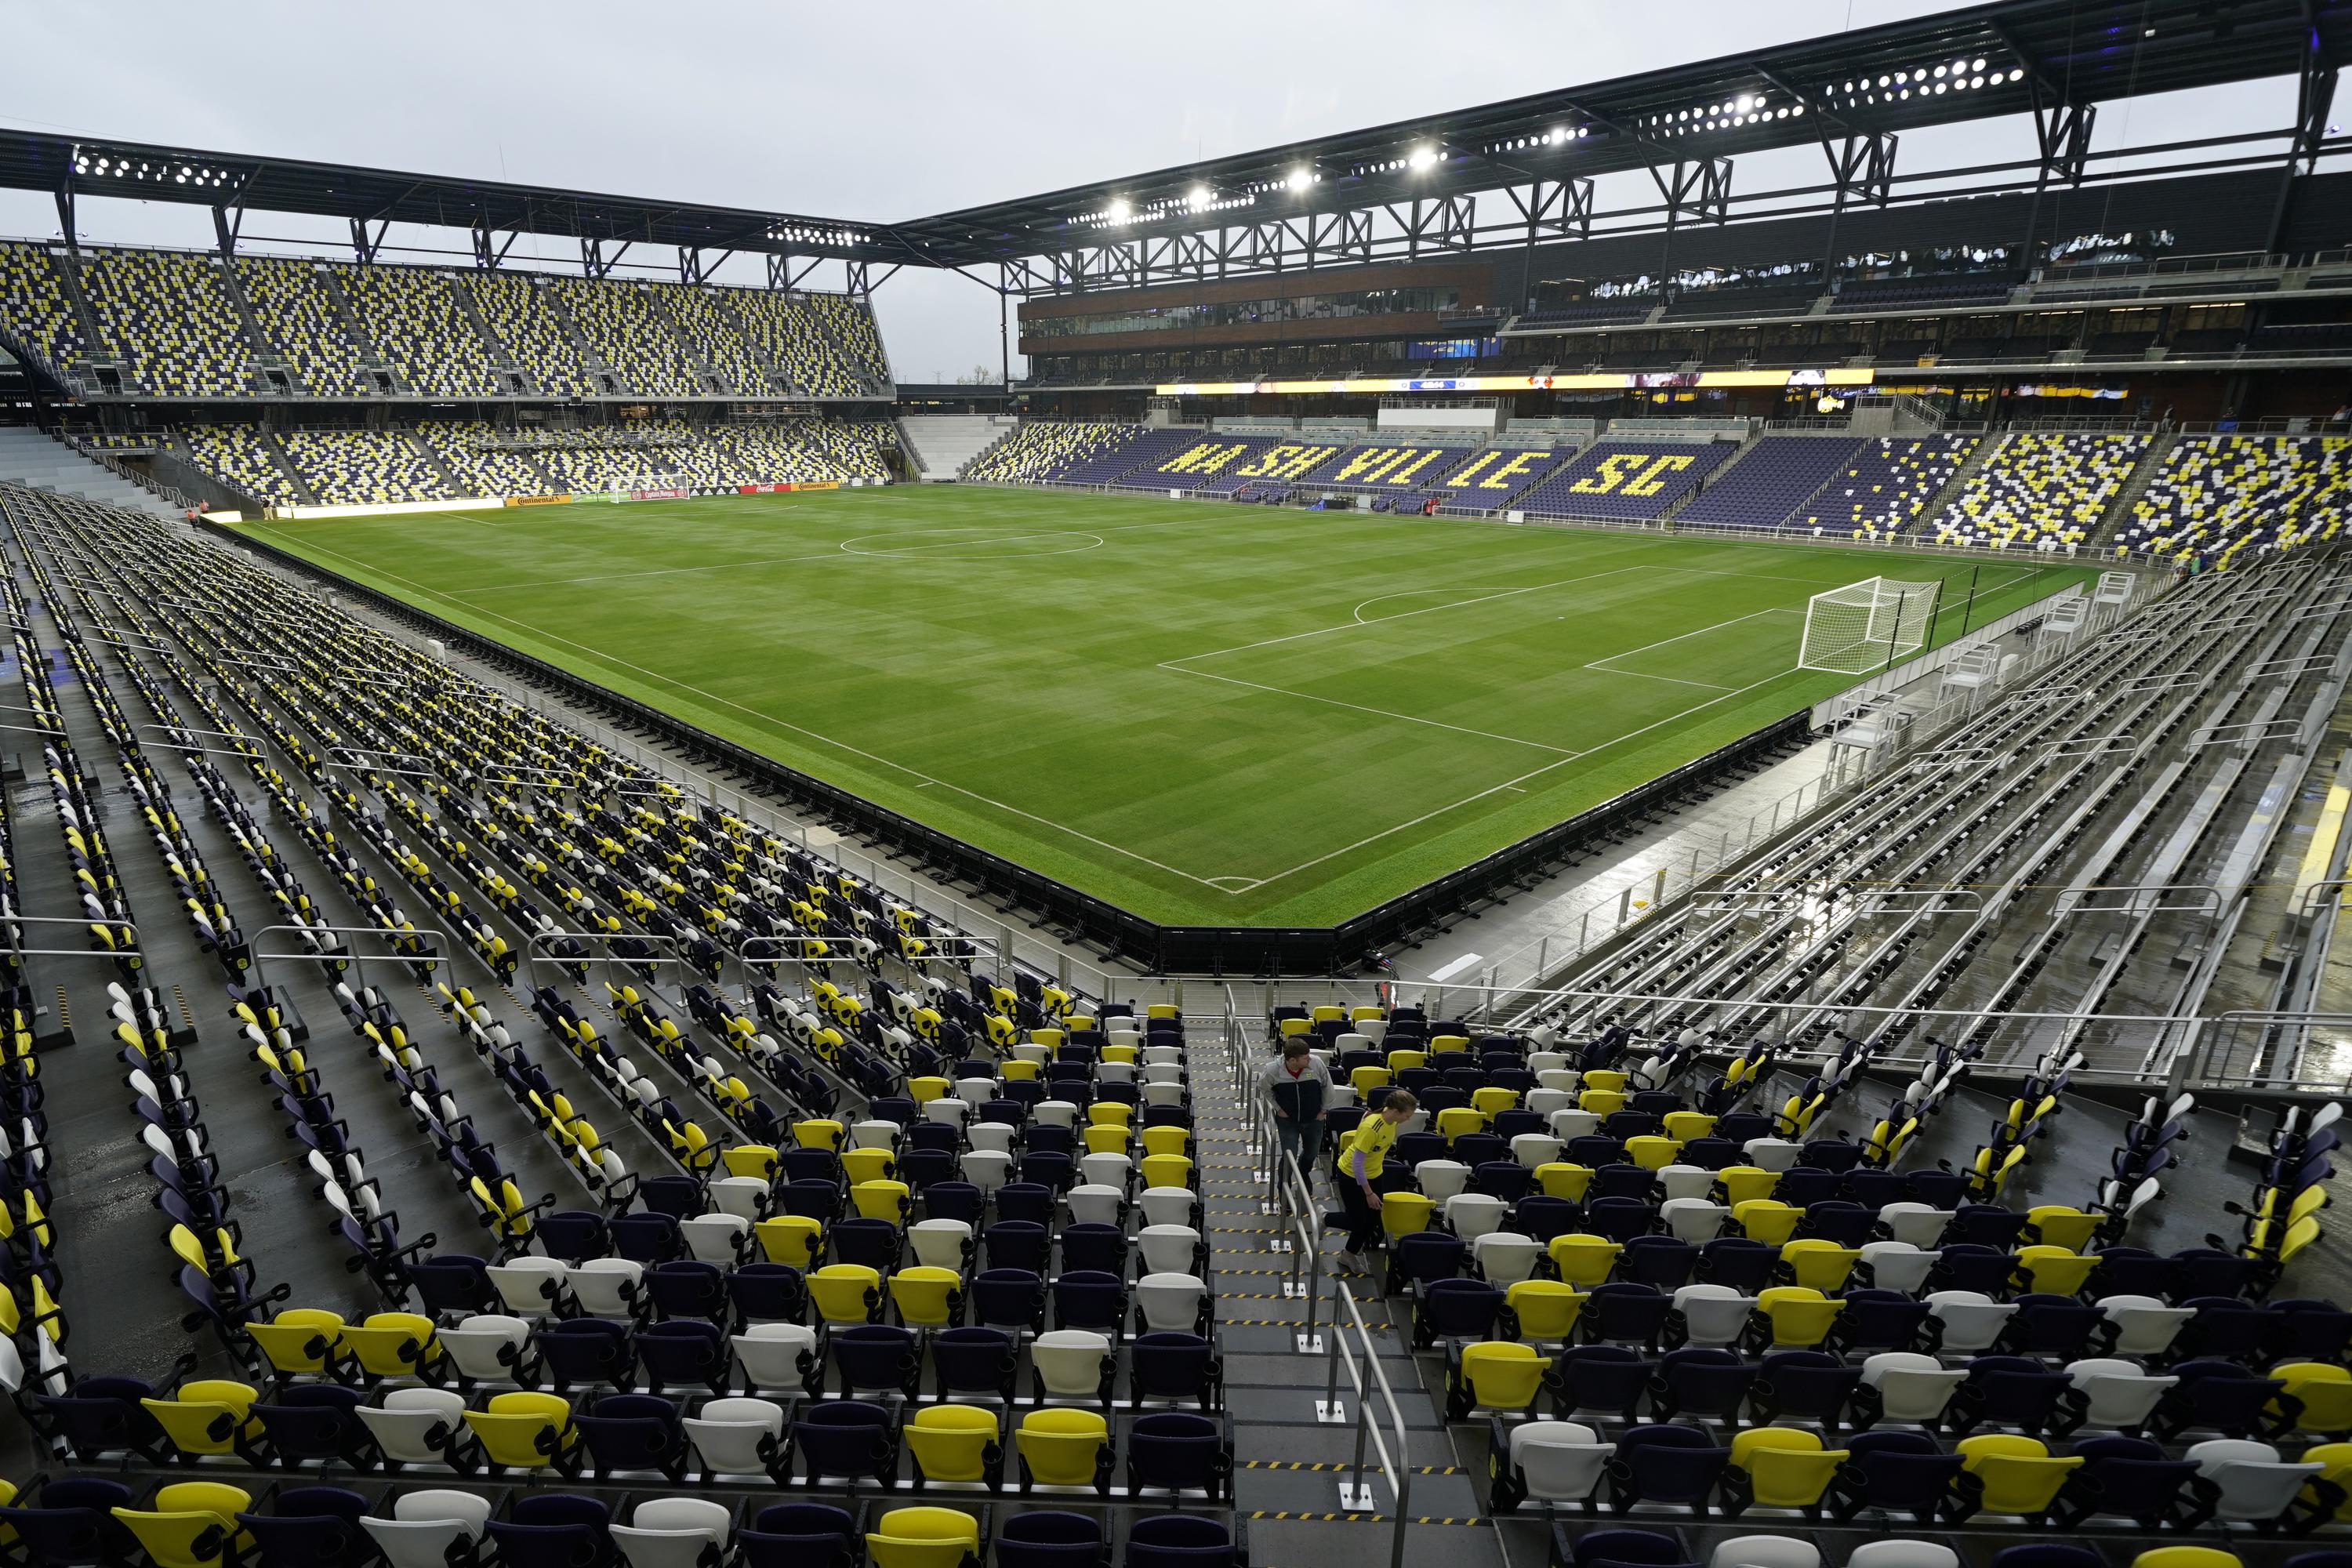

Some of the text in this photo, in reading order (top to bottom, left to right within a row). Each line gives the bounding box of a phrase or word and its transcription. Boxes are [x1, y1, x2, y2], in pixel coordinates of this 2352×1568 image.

[1157, 443, 1695, 496] NASHVILLE SC
[799, 482, 826, 491] Continental
[659, 489, 675, 498] Morgan
[517, 496, 554, 506] Continental
